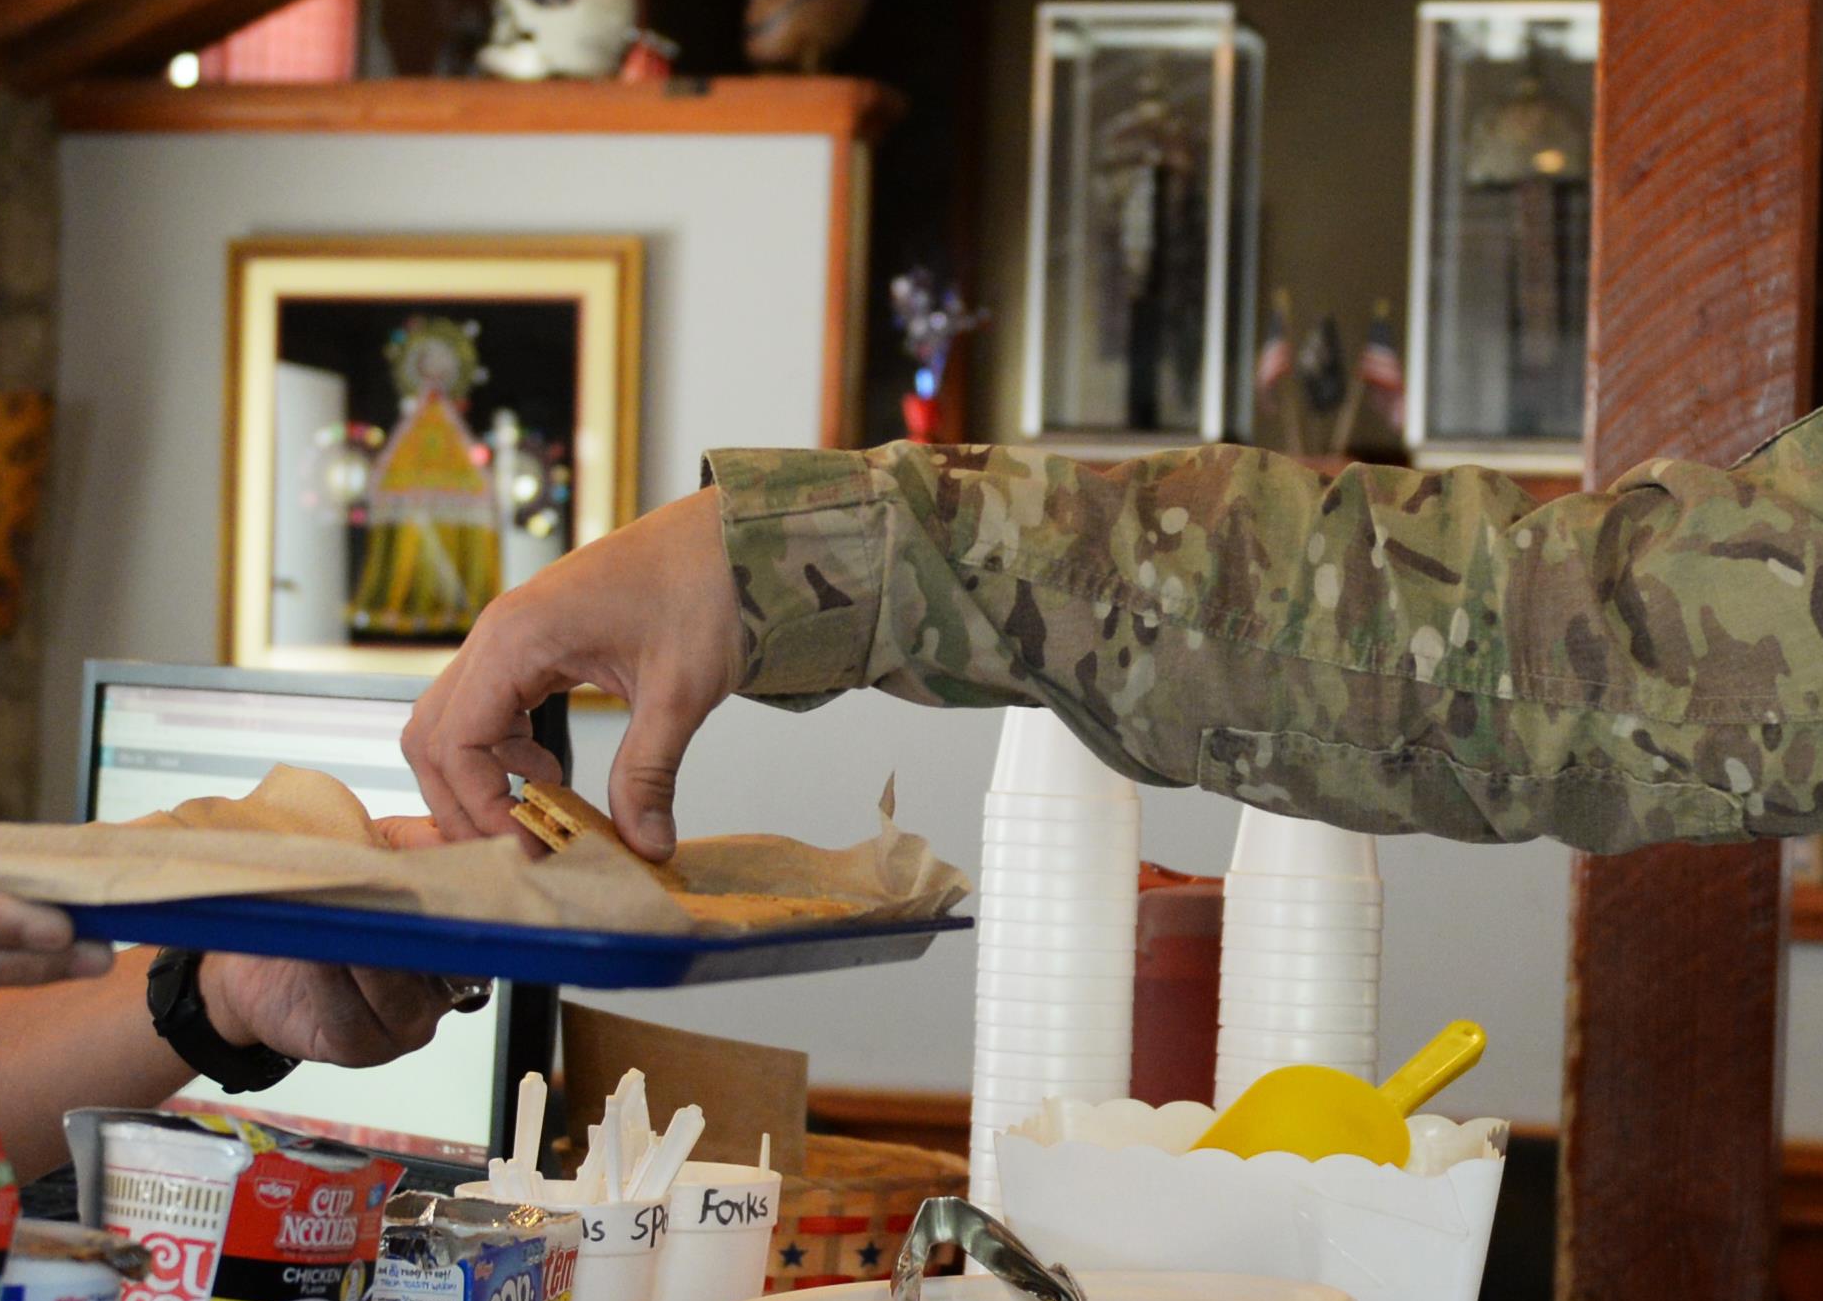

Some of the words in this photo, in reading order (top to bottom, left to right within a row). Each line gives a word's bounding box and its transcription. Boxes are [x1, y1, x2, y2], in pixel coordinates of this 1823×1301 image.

[310, 1187, 355, 1217] CUP
[698, 1188, 769, 1226] Forks
[277, 1214, 359, 1247] NOODLES
[282, 1266, 344, 1284] CHICKEN
